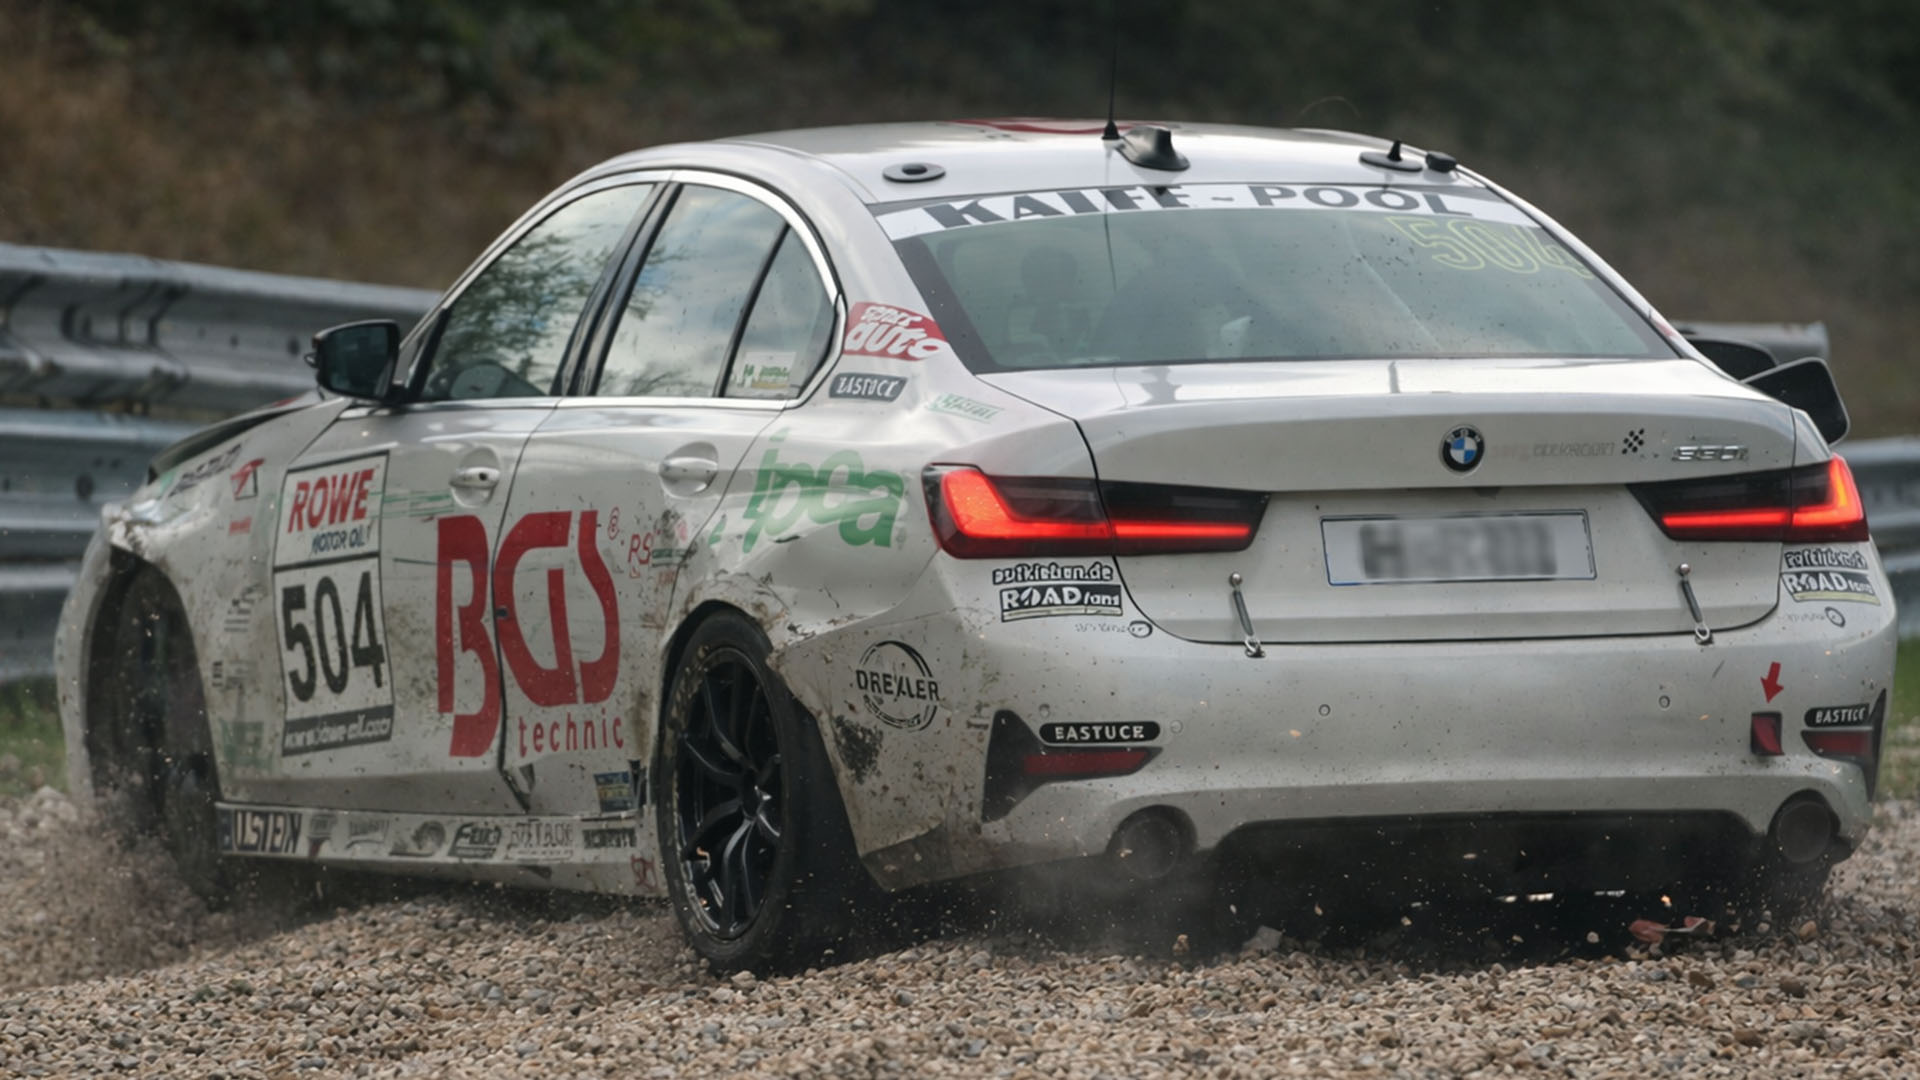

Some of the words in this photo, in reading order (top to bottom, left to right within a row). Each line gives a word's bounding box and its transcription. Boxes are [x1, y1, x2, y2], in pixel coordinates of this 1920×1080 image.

[1248, 184, 1473, 217] POOL
[1384, 214, 1594, 280] 504
[287, 468, 375, 533] ROWE
[1002, 586, 1081, 609] ROAD
[282, 571, 385, 702] 504
[436, 510, 621, 758] BGS
[856, 669, 940, 702] DREXLER
[518, 707, 625, 758] technic
[1054, 725, 1145, 741] EASTUCE
